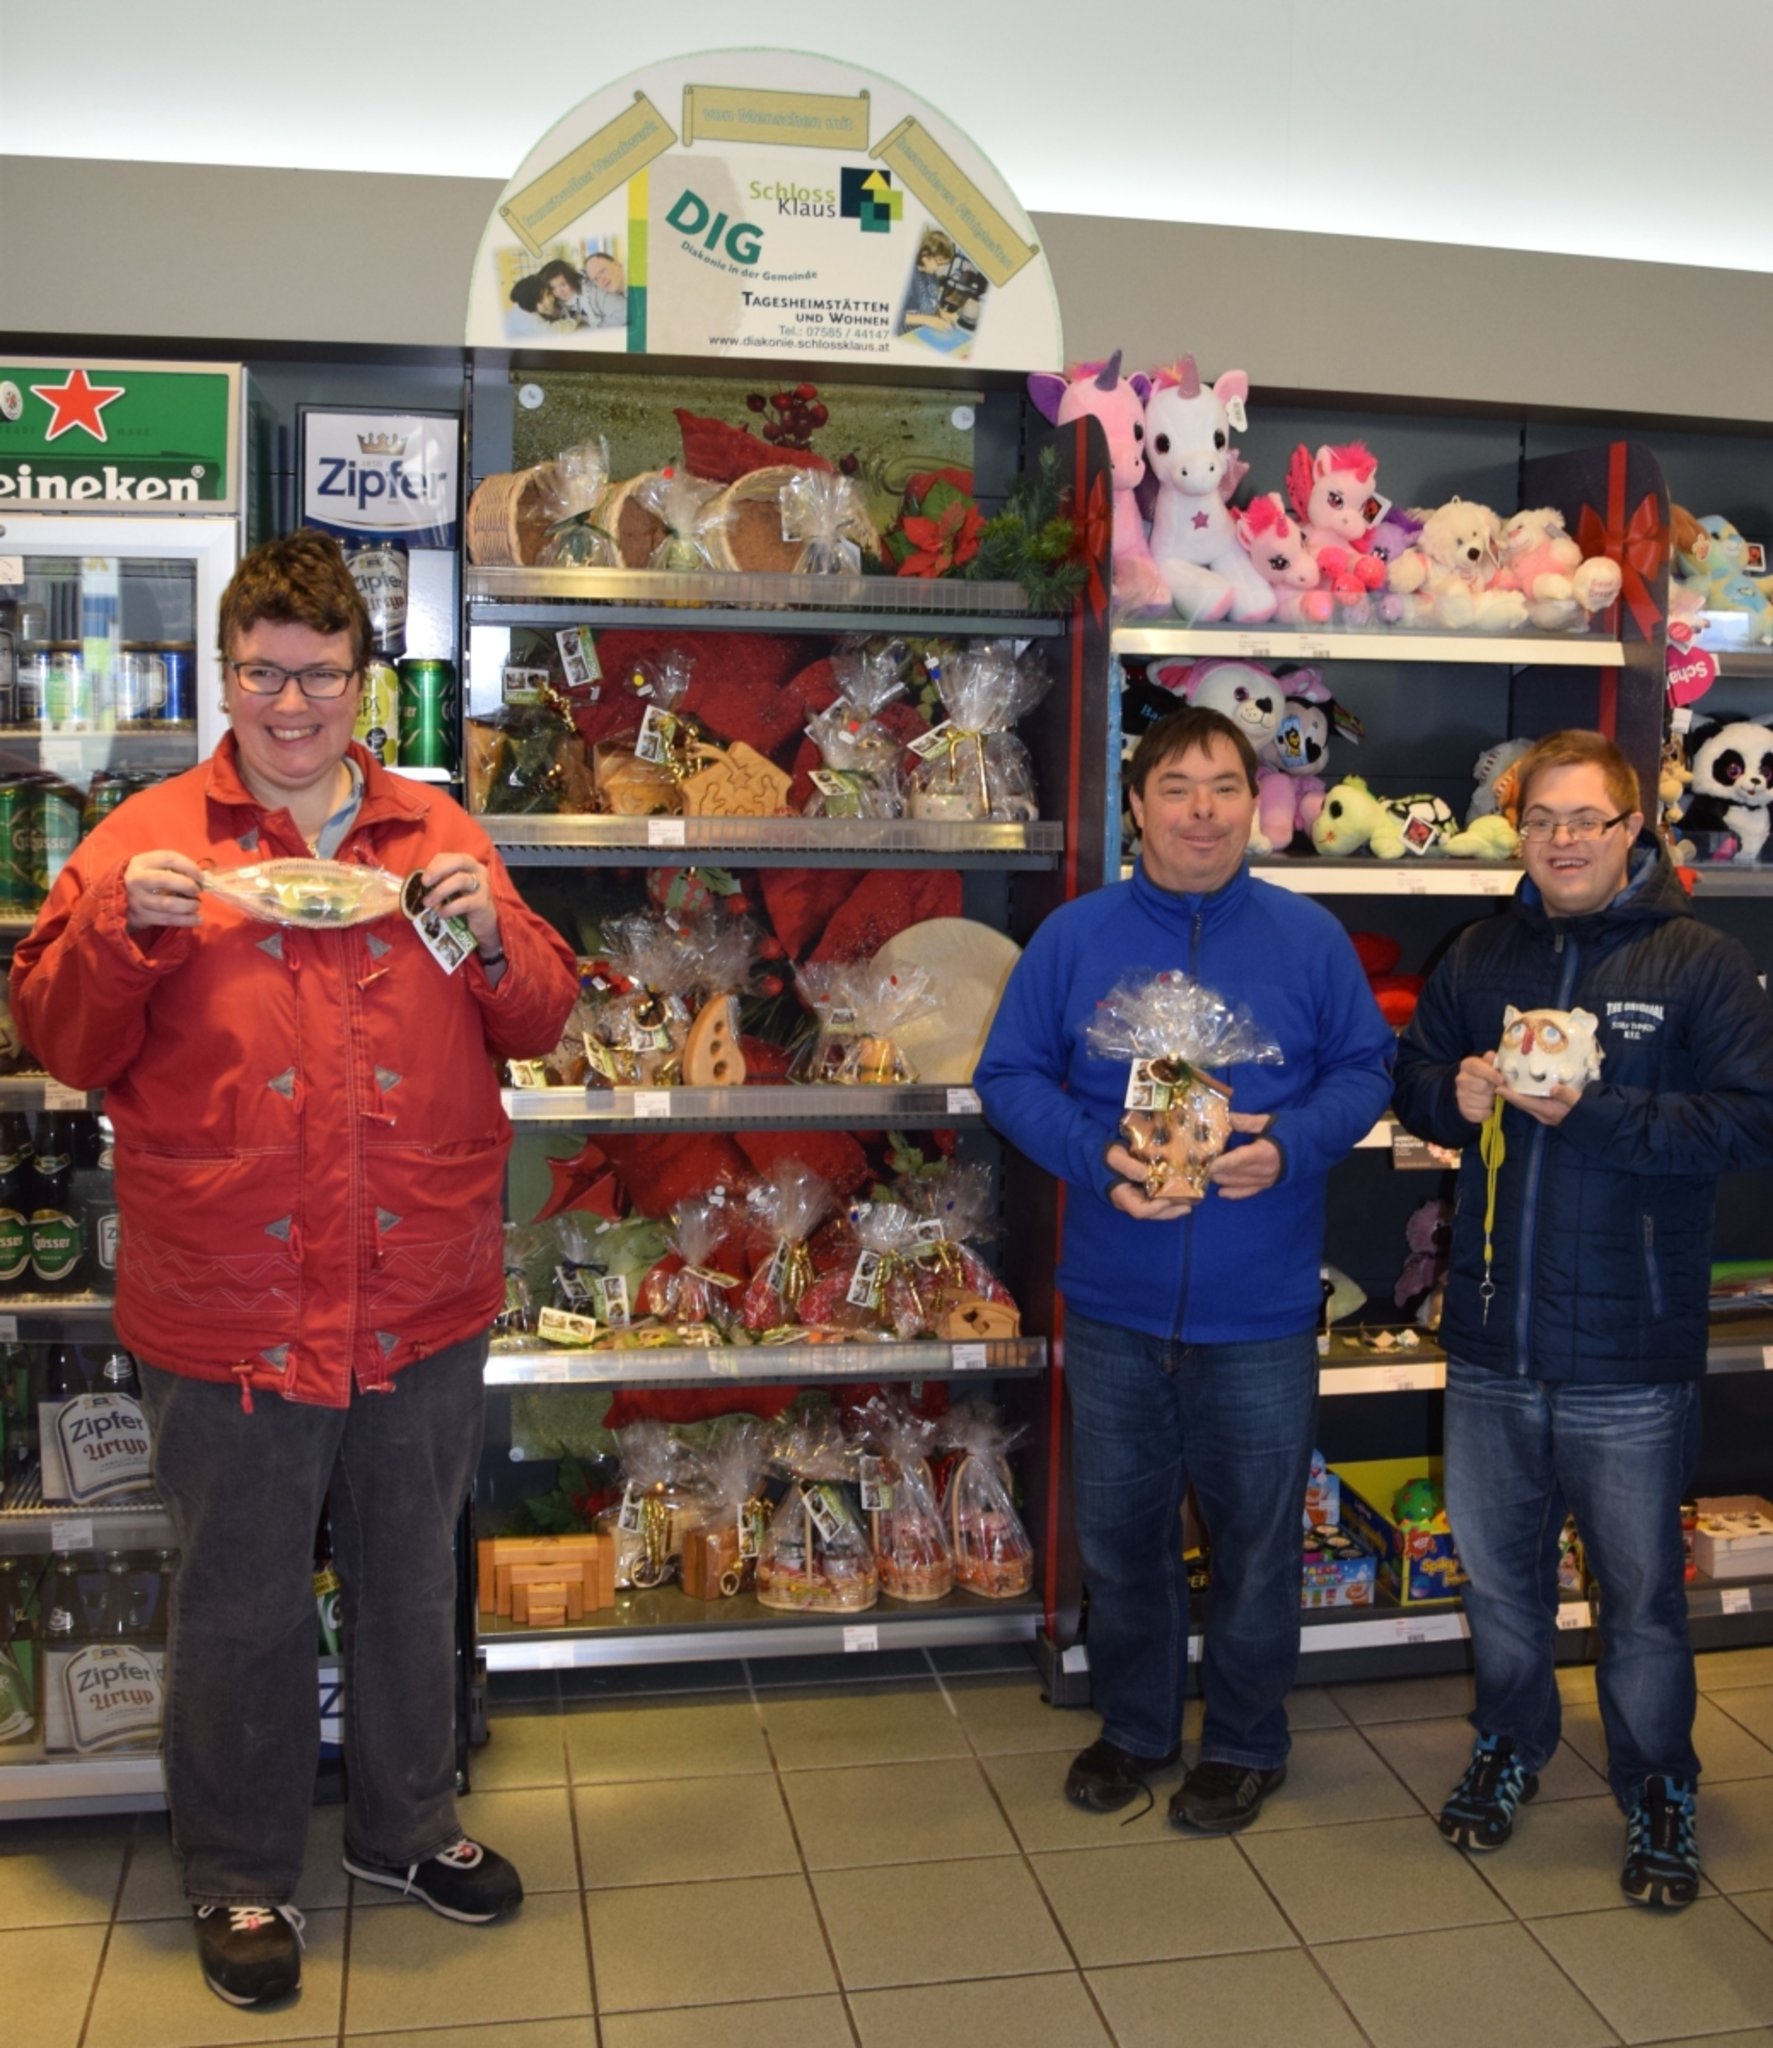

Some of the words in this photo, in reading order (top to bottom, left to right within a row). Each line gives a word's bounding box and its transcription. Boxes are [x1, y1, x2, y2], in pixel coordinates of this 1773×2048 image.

[737, 108, 822, 129] Menschen
[749, 180, 836, 203] Schloss
[778, 198, 836, 218] Klaus
[665, 189, 764, 265] DIG
[681, 240, 727, 271] Diakonie
[728, 264, 739, 275] in
[741, 268, 759, 279] der
[762, 270, 818, 282] Gemeinde
[742, 291, 890, 313] TAGESHEIMSTÄTTEN
[709, 335, 890, 353] www.diakonie.schlossklaus.at
[854, 329, 890, 339] 44147
[317, 456, 448, 510] Zipfer
[69, 1410, 144, 1443] Zipfer
[83, 1438, 148, 1461] Urtyp
[77, 1662, 150, 1693] Zipfer
[89, 1688, 155, 1711] Urtyp
